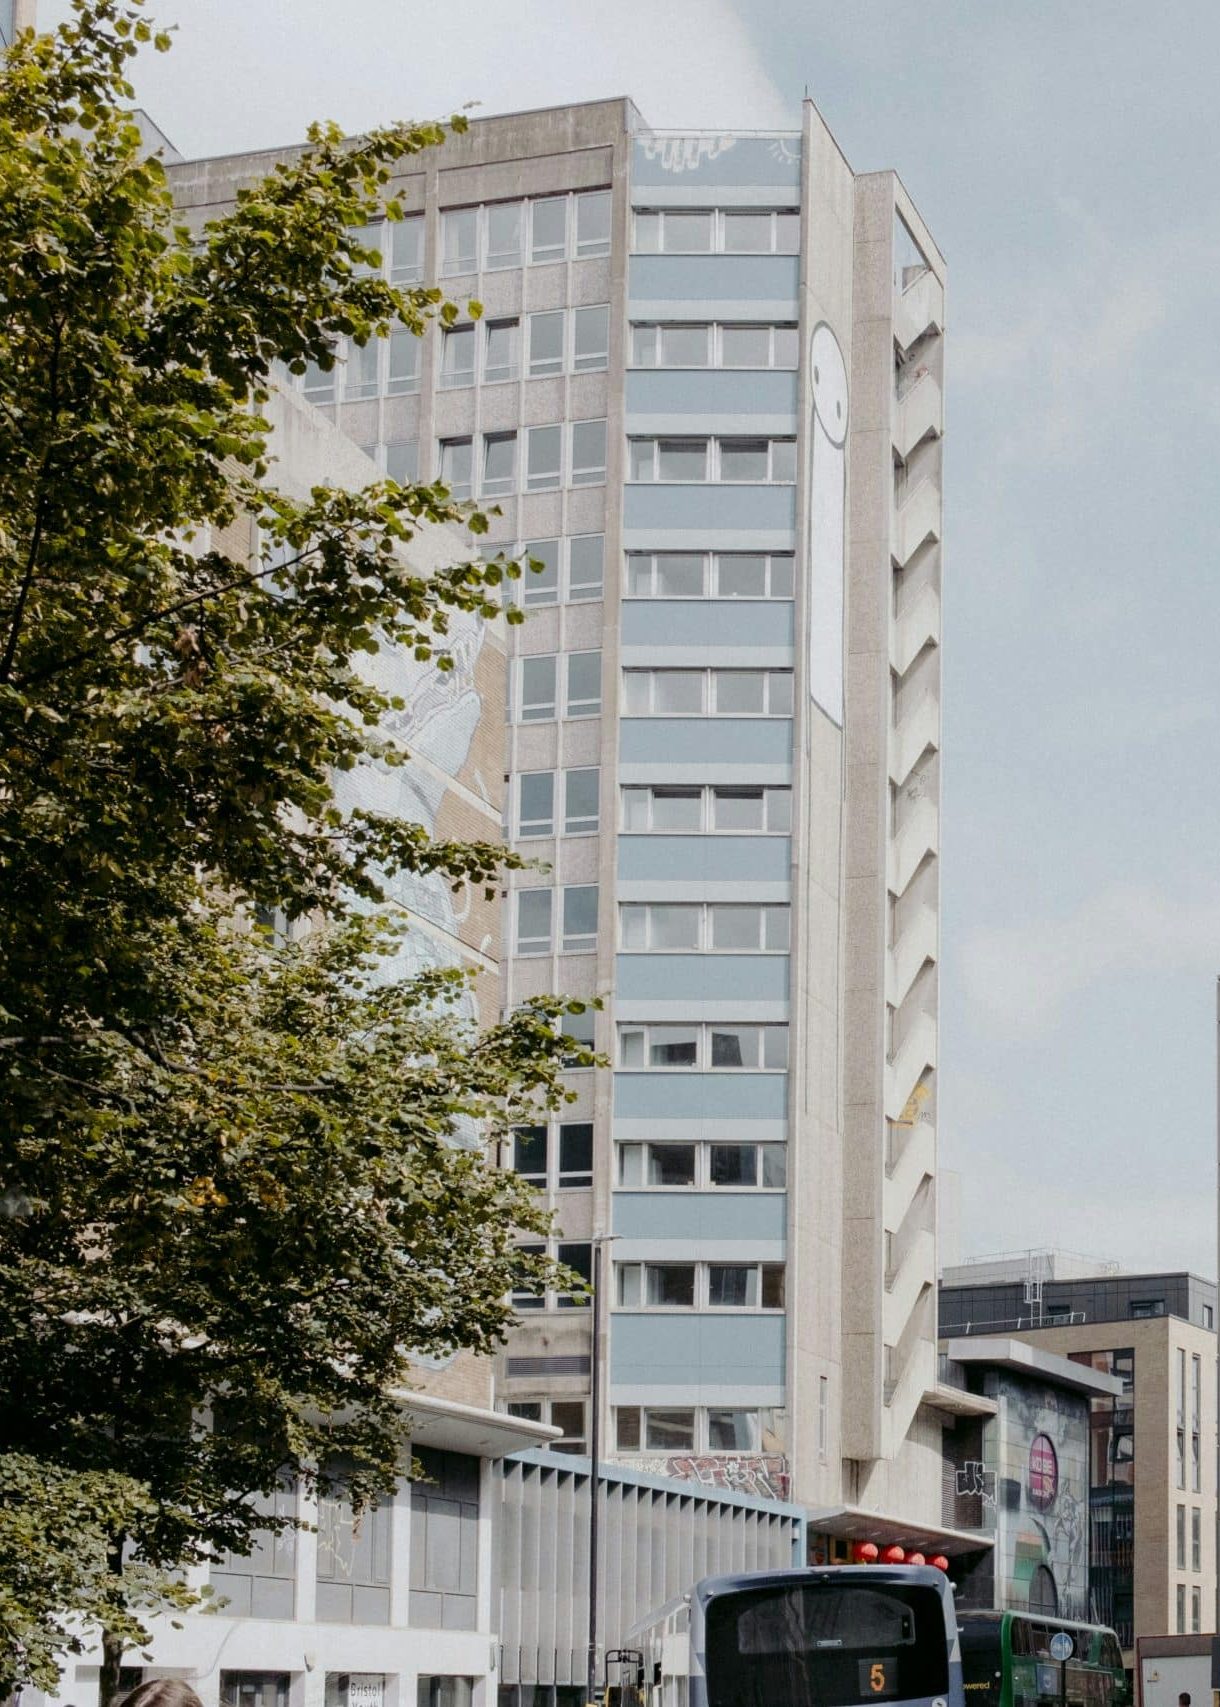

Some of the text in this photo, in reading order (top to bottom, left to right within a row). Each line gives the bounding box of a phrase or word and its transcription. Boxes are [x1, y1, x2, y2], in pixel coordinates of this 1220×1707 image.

[869, 1663, 886, 1693] 5
[962, 1681, 990, 1690] owered
[350, 1682, 380, 1697] Bristol
